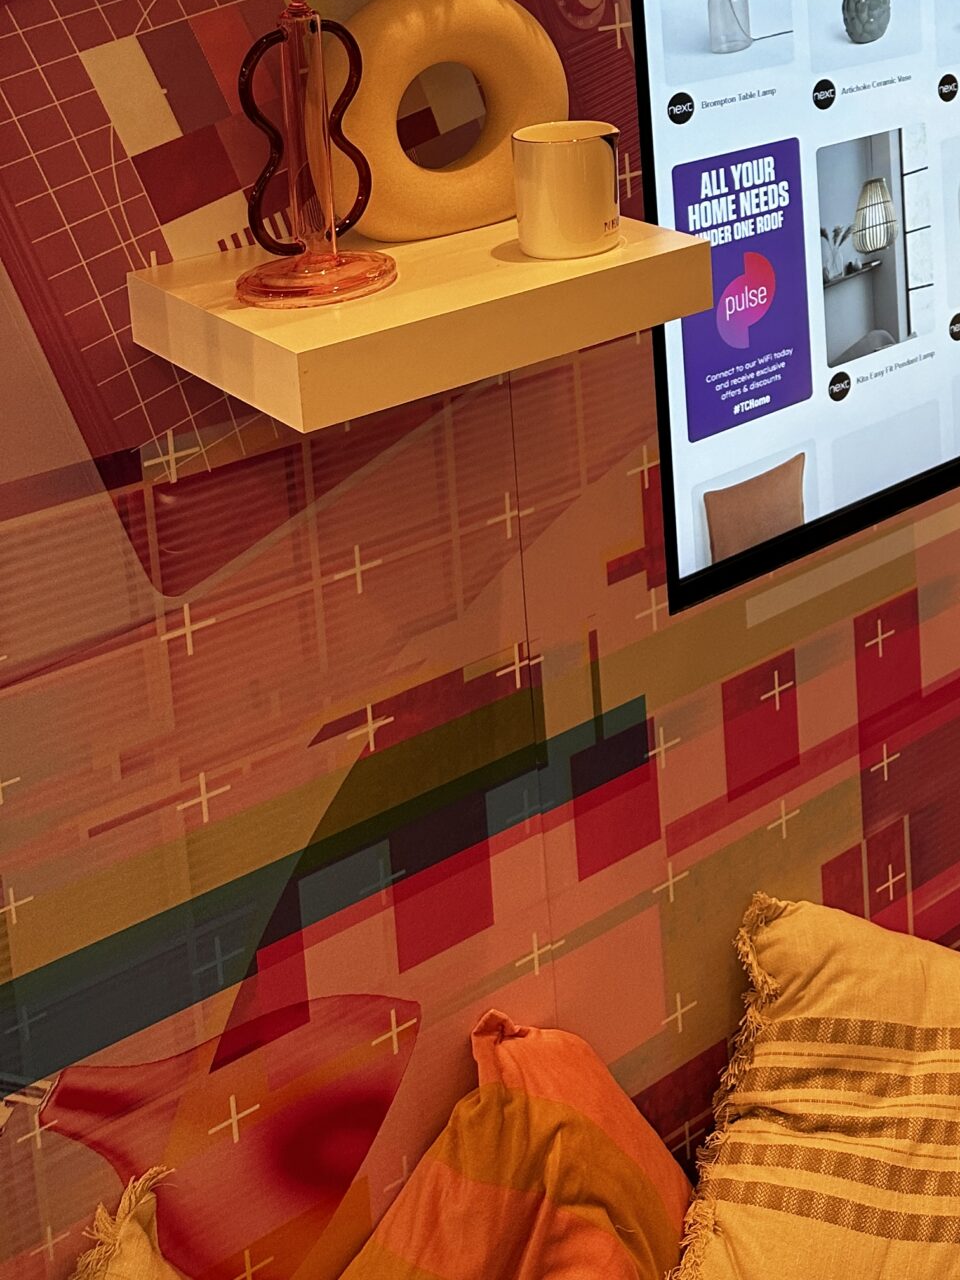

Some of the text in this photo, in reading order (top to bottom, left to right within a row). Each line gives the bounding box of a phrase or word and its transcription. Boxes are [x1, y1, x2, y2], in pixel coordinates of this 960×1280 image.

[813, 88, 835, 100] next
[841, 83, 871, 95] Artichoke
[872, 77, 897, 88] Ceramic
[939, 82, 958, 94] next
[668, 102, 693, 115] next
[701, 88, 777, 109] Brompton Table Lamp
[701, 156, 776, 200] ALL YOUR
[688, 180, 790, 232] HOME NEEDS
[695, 210, 784, 247] NDER ONE ROOF
[725, 286, 768, 321] pulse
[706, 347, 794, 383] Connect to our WiFi today
[919, 351, 935, 362] Lamp
[715, 361, 786, 392] and receive exclusive
[720, 374, 782, 401] offers & discounts
[829, 379, 850, 394] next
[733, 394, 771, 416] #TCHome
